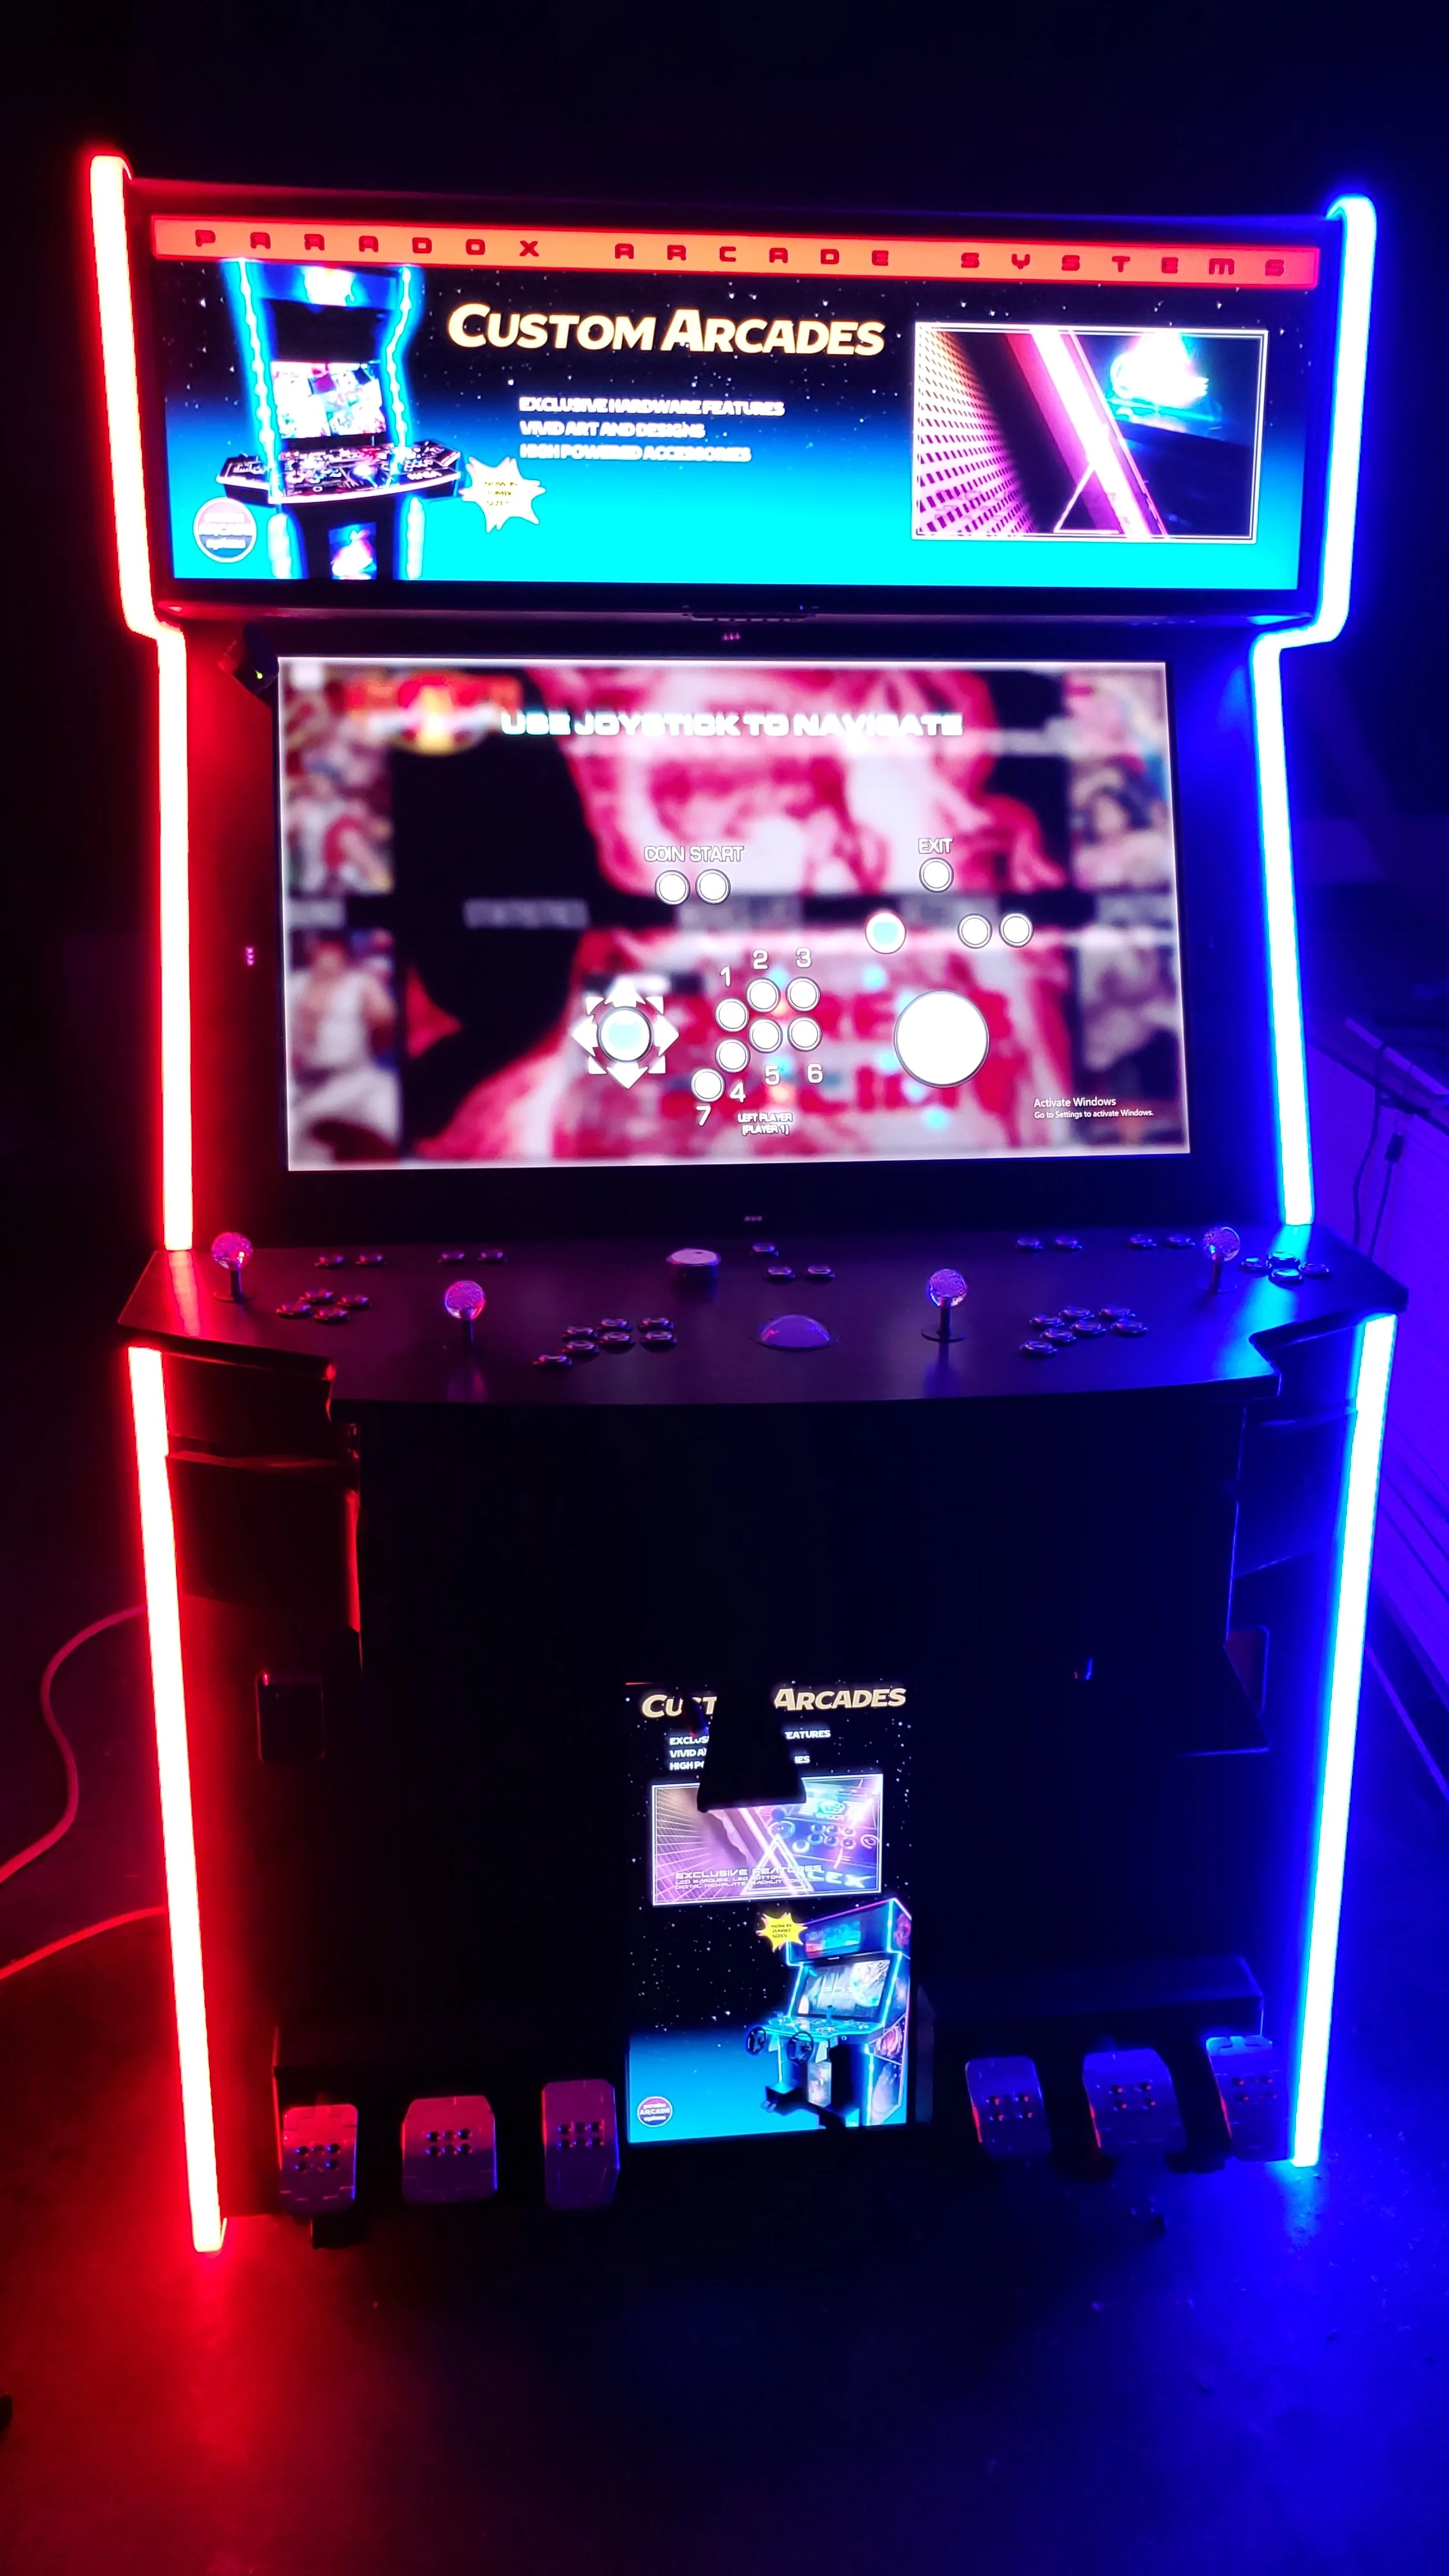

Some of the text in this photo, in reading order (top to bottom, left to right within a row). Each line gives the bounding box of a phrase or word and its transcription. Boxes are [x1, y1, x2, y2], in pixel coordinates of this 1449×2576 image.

[195, 230, 1285, 276] PARADOX ARCADE SYSTEMS
[448, 303, 885, 356] CUSTOM ARCADES
[519, 397, 785, 416] EXCLUSIVE HARDWARE FEATURES
[520, 421, 705, 438] VIVID ART AND DESIGNS
[520, 443, 752, 463] HIGH POWERED ACCESSORIES
[501, 712, 963, 737] USE JOYSTICK TO NAVIGATE
[645, 846, 744, 862] COIN START
[918, 838, 953, 854] EXIT
[752, 949, 768, 970] 2
[795, 947, 811, 968] 3
[720, 966, 731, 987] 1
[764, 1065, 780, 1085] 5
[807, 1063, 823, 1084] 6
[729, 1082, 747, 1103] 4
[1034, 1096, 1117, 1108] Activate Windows
[696, 1106, 711, 1126] 7
[738, 1112, 792, 1123] LEFT PLAYER
[1034, 1111, 1044, 1119] Go
[1055, 1110, 1083, 1120] Settings
[1093, 1109, 1119, 1118] activate
[1120, 1108, 1154, 1117] Windows.
[774, 1687, 906, 1711] ARCADES
[785, 1729, 831, 1740] EATURES
[669, 1748, 696, 1758] VIVID
[669, 1762, 694, 1771] HIGH
[675, 1864, 822, 1880] EXCLUSIVE FEATURES
